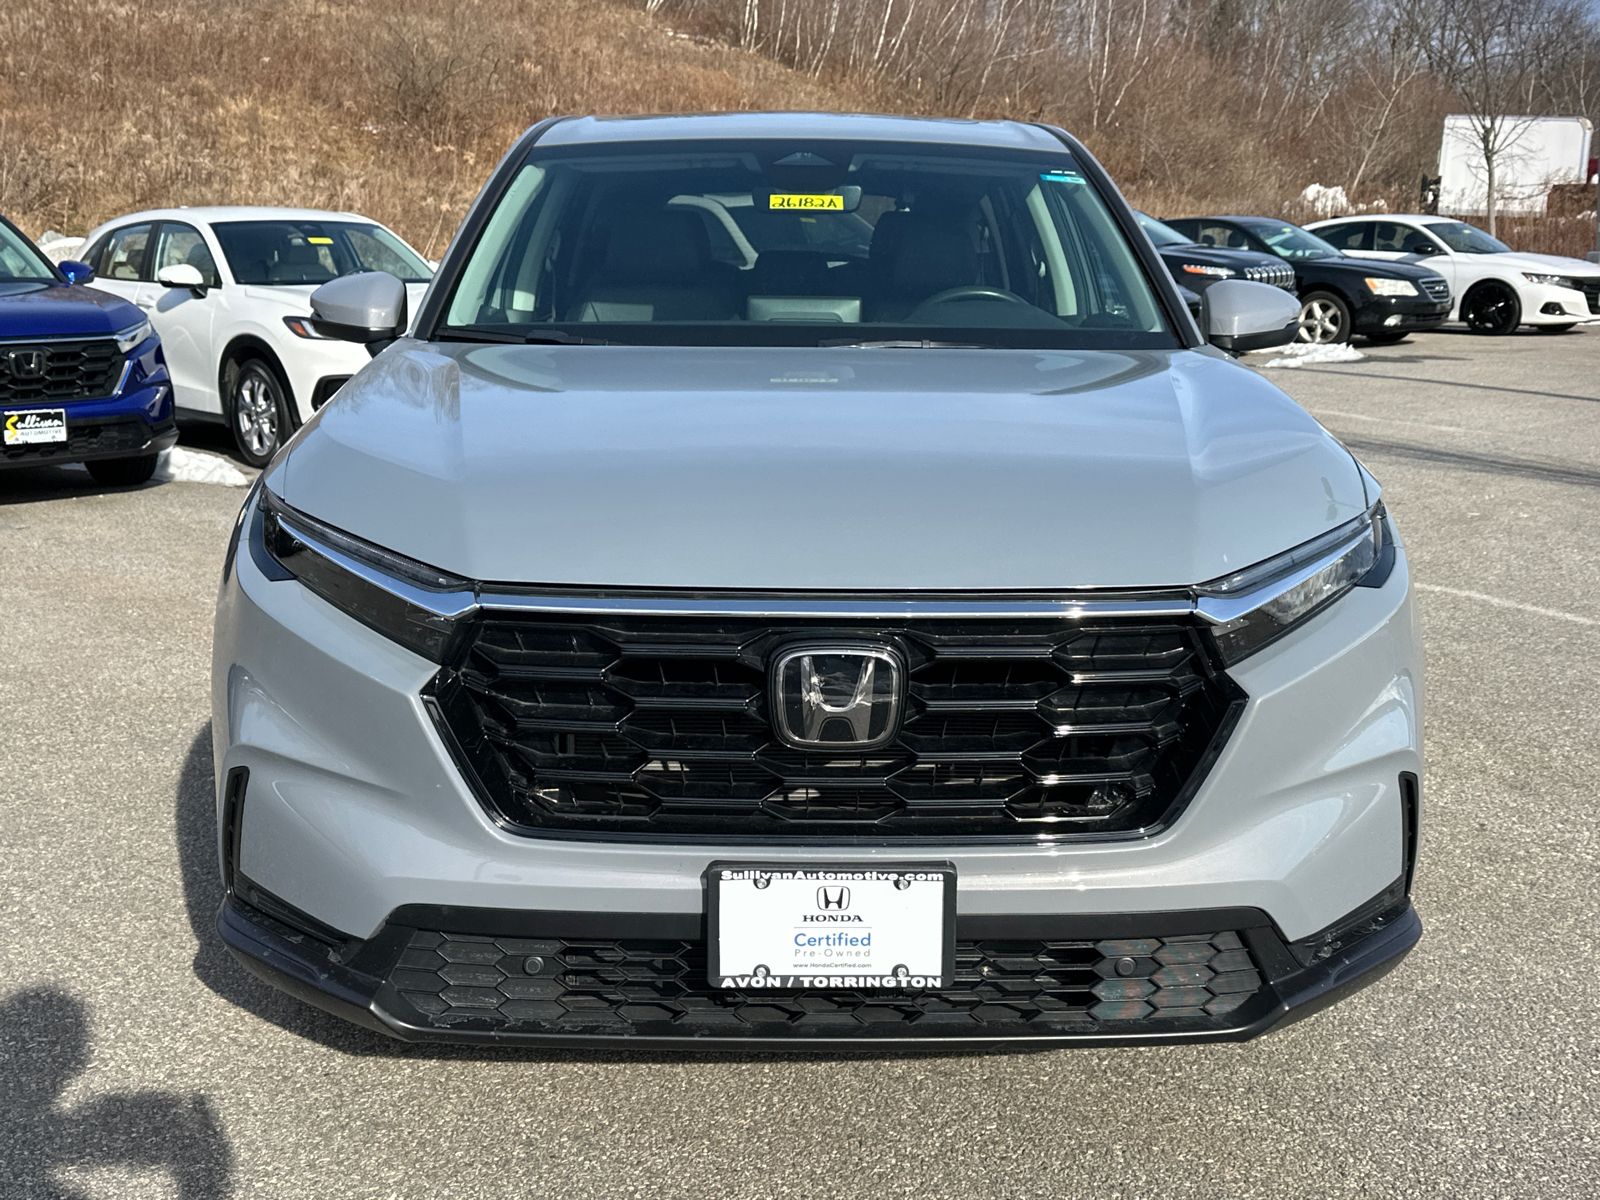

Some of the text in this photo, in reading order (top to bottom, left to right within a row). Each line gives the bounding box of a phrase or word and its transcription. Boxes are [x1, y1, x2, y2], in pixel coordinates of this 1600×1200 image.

[771, 196, 837, 208] 26182A
[6, 414, 63, 439] Sullivan
[720, 870, 944, 881] SullivanAutomotive.com
[802, 914, 864, 923] HONDA
[794, 932, 872, 947] Certified
[794, 948, 871, 958] Pre-Owned
[720, 976, 781, 988] AVON
[799, 976, 942, 988] TORRINGTON
